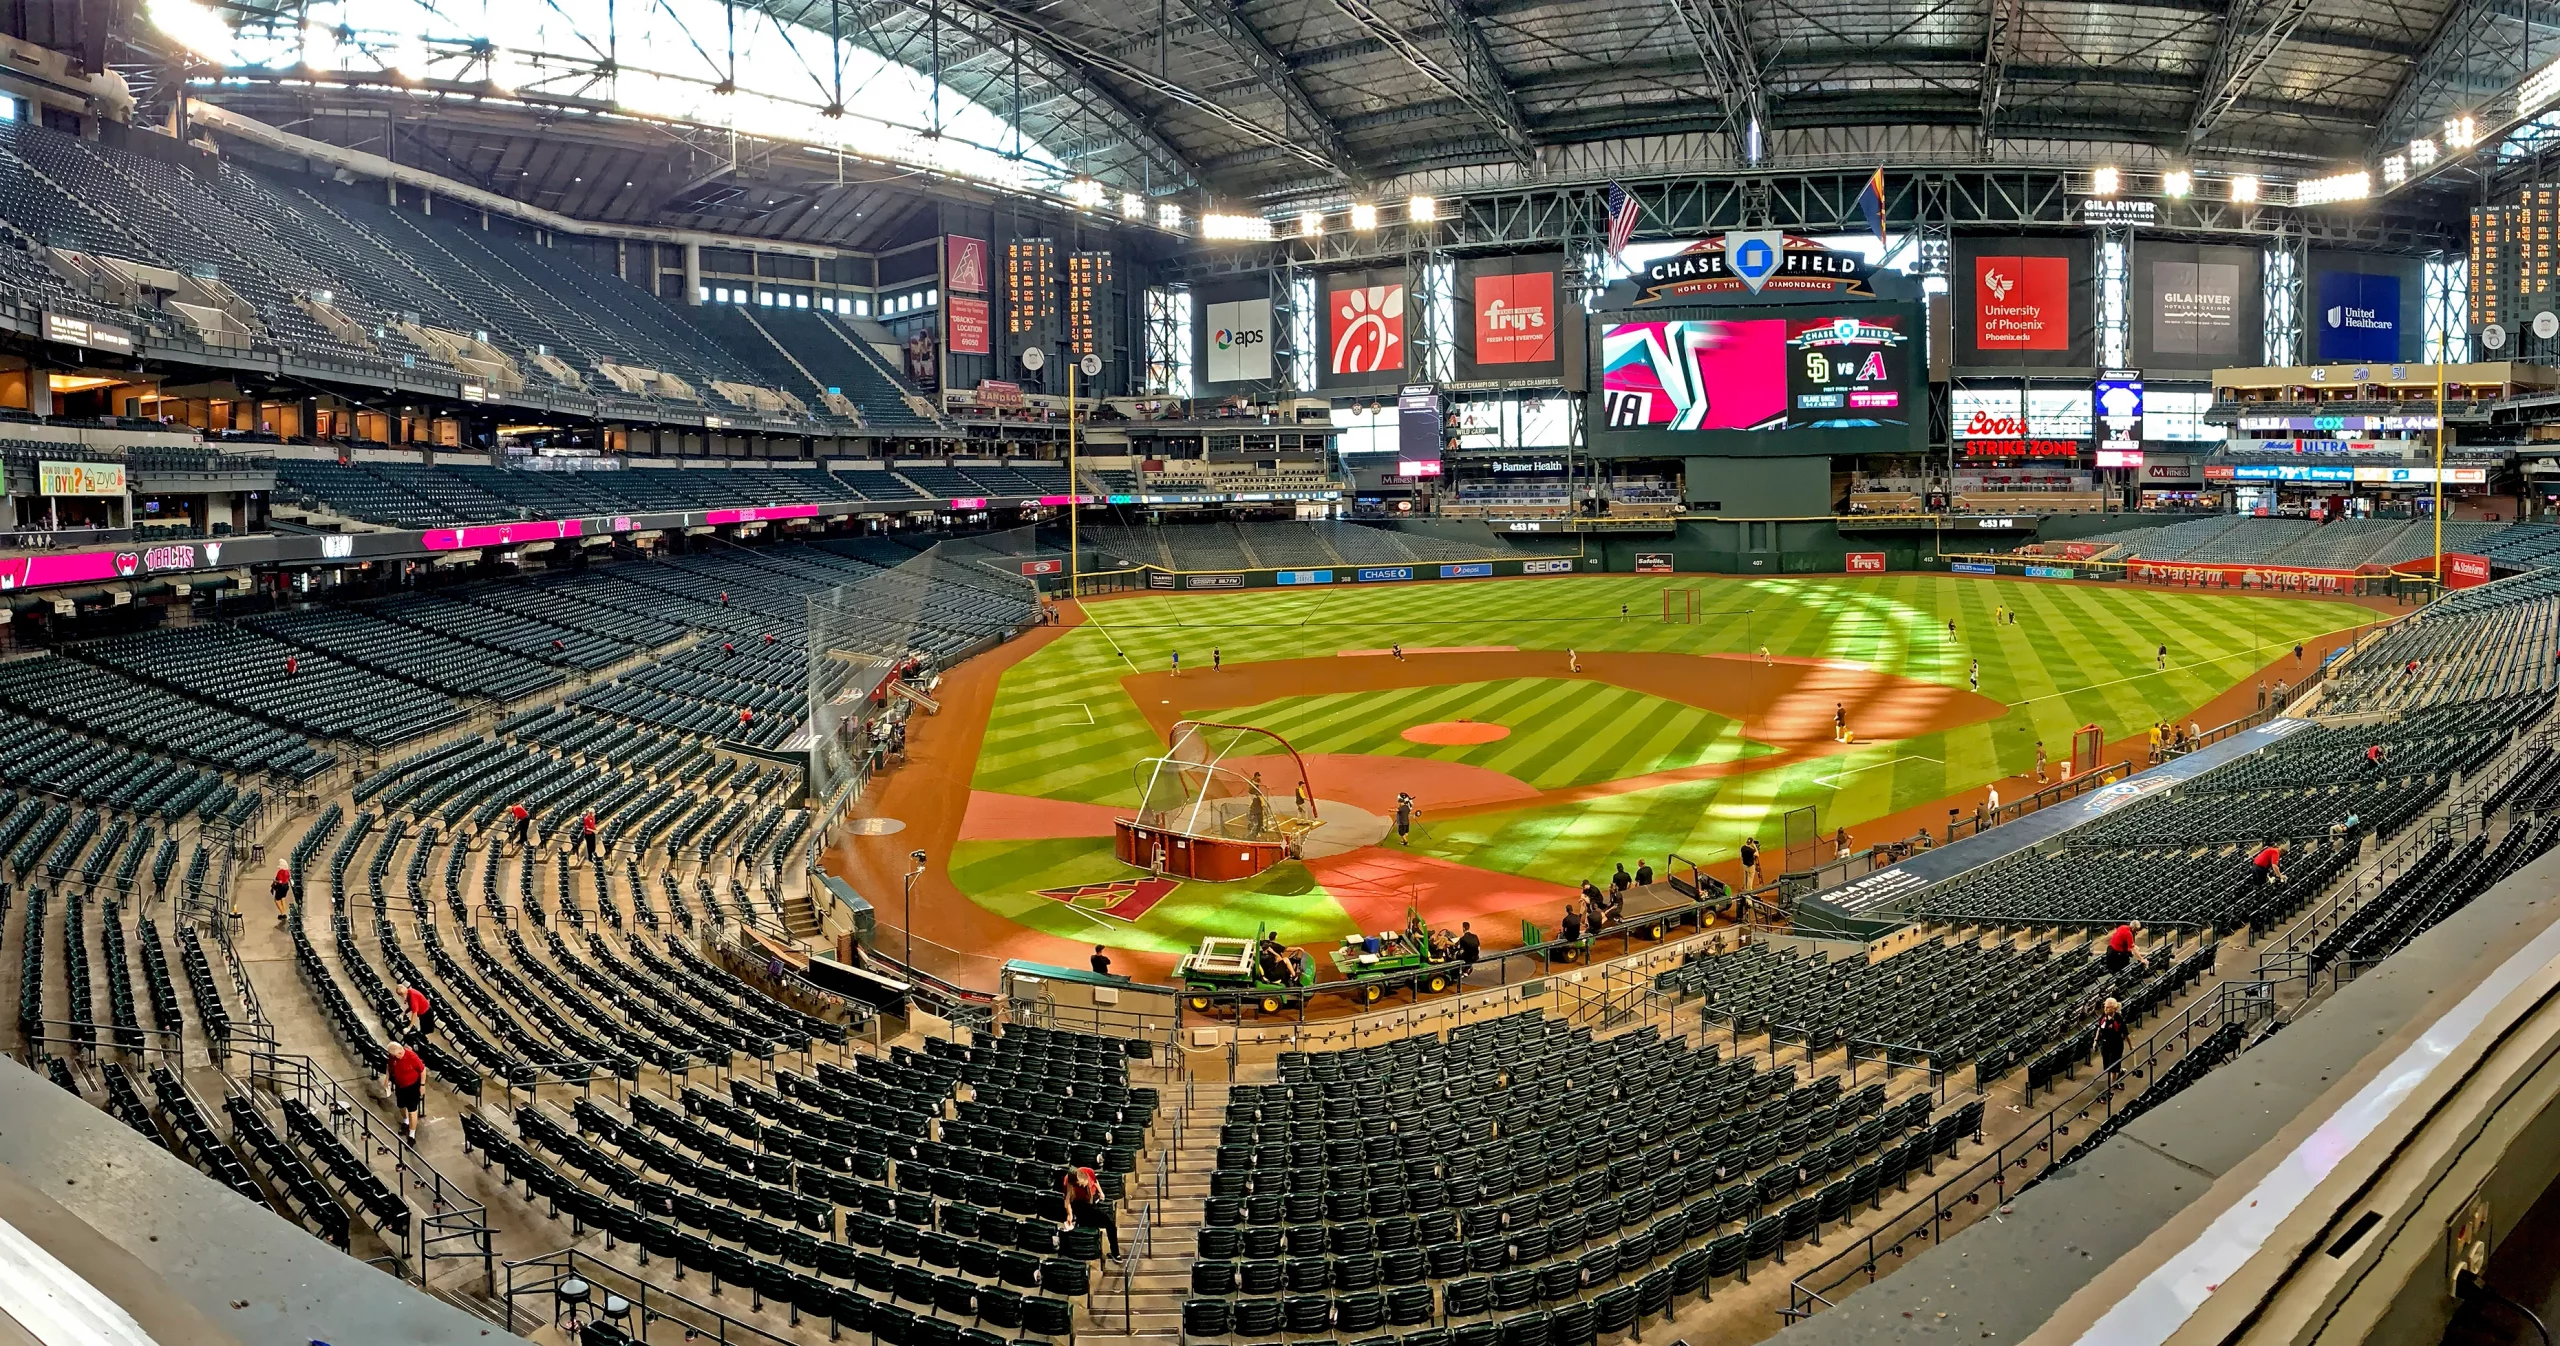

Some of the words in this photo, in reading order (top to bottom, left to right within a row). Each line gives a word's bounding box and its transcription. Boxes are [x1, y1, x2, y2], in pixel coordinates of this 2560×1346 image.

[2084, 200, 2115, 211] GILA
[2116, 201, 2154, 212] RIVER
[1651, 257, 1722, 280] CHASE
[1787, 255, 1855, 273] FIELD
[1677, 284, 1700, 293] HOME
[1768, 281, 1832, 289] DIAMONDBACKS
[2164, 293, 2193, 303] GILA
[2194, 294, 2231, 305] RIVER
[1484, 299, 1544, 331] fry's
[1985, 305, 2040, 319] University
[2345, 307, 2375, 319] United
[957, 325, 982, 333] LOCATION
[1985, 319, 1997, 329] of
[1999, 319, 2043, 330] Phoenix
[2345, 317, 2393, 330] Healthcare
[1235, 329, 1263, 348] aps
[1805, 330, 1834, 341] CHASE
[1860, 328, 1890, 338] FIELD
[1985, 333, 2031, 341] Phoenix.edu
[1807, 352, 1830, 383] SD
[1837, 362, 1854, 375] VS
[2353, 366, 2370, 381] 20
[2392, 366, 2407, 380] 51
[2310, 368, 2326, 381] 42
[1966, 410, 2028, 435] Coors
[2313, 417, 2345, 429] COX
[1966, 440, 2026, 455] STRIKE
[2029, 440, 2077, 455] ZONE
[2260, 441, 2294, 450] Michelob
[2303, 441, 2349, 453] ULTRA
[1503, 462, 1532, 471] Banner
[1533, 461, 1563, 471] Health
[2152, 468, 2164, 476] M
[1109, 494, 1131, 504] COX
[1510, 523, 1527, 531] 4:53
[1528, 523, 1540, 531] PM
[1979, 519, 1997, 528] 4:53
[1999, 519, 2013, 528] PM
[1524, 560, 1572, 572] GEICO
[1851, 554, 1881, 570] fry's
[1365, 570, 1397, 578] CHASE
[1462, 566, 1479, 574] pepsi
[2031, 568, 2047, 576] COX
[2051, 569, 2068, 577] COX
[1820, 885, 1859, 901] GILA
[1856, 868, 1905, 889] RIVER
